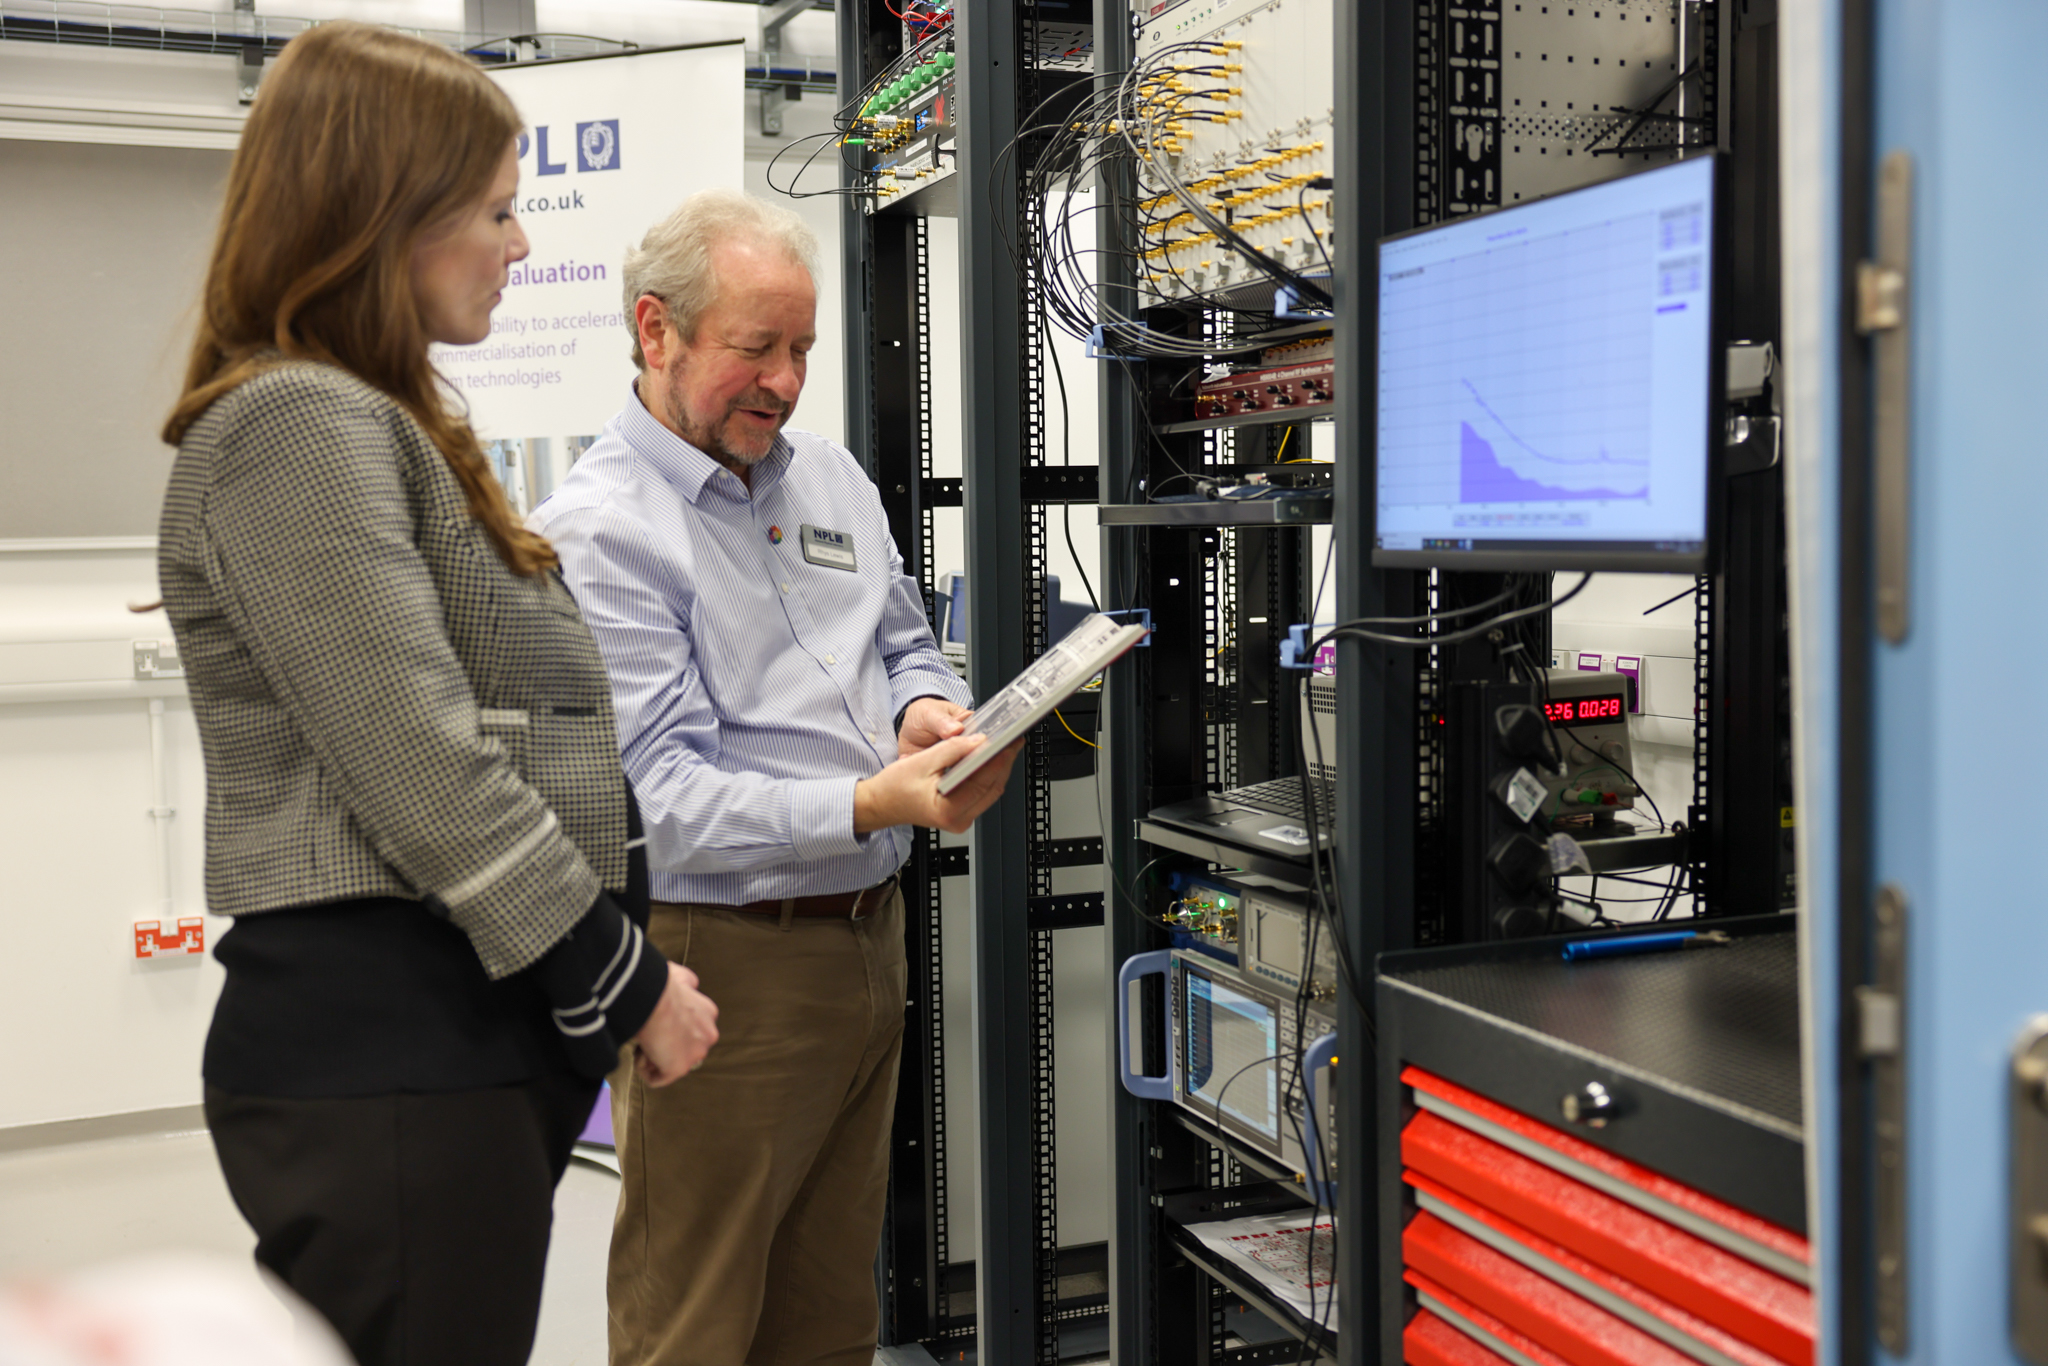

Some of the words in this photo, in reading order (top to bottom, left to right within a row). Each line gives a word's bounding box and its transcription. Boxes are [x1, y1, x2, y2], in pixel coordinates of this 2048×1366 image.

[508, 260, 606, 286] aluation
[532, 317, 548, 331] to
[560, 339, 577, 355] of
[467, 368, 562, 388] technologies
[813, 529, 835, 542] NPL
[1579, 699, 1619, 719] 0.028
